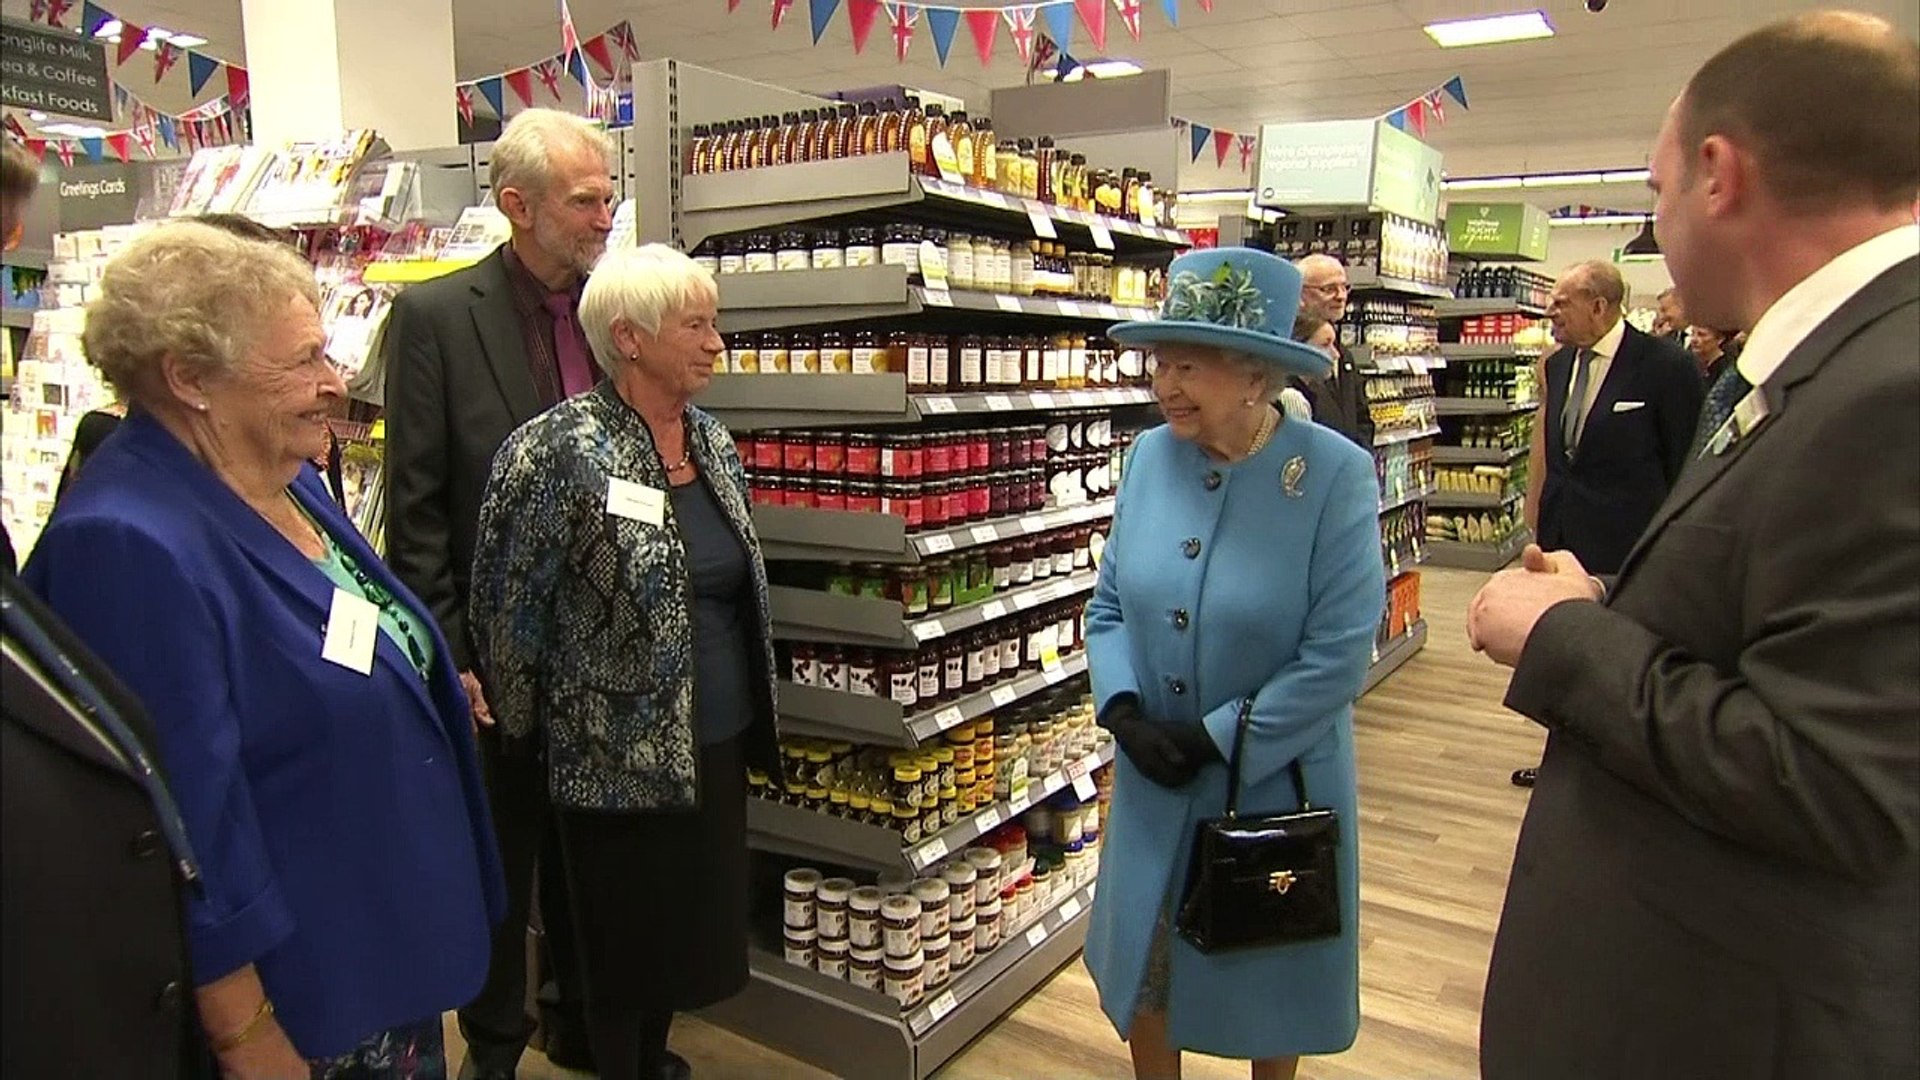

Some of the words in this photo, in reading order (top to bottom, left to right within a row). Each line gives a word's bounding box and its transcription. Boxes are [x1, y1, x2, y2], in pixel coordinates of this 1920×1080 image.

[1, 35, 57, 54] onglife
[60, 43, 92, 61] Milk
[1, 60, 23, 73] ea
[27, 62, 39, 76] &
[43, 65, 97, 87] Coffee
[1, 84, 44, 106] kfast
[48, 93, 98, 113] Foods
[100, 177, 125, 194] Cards
